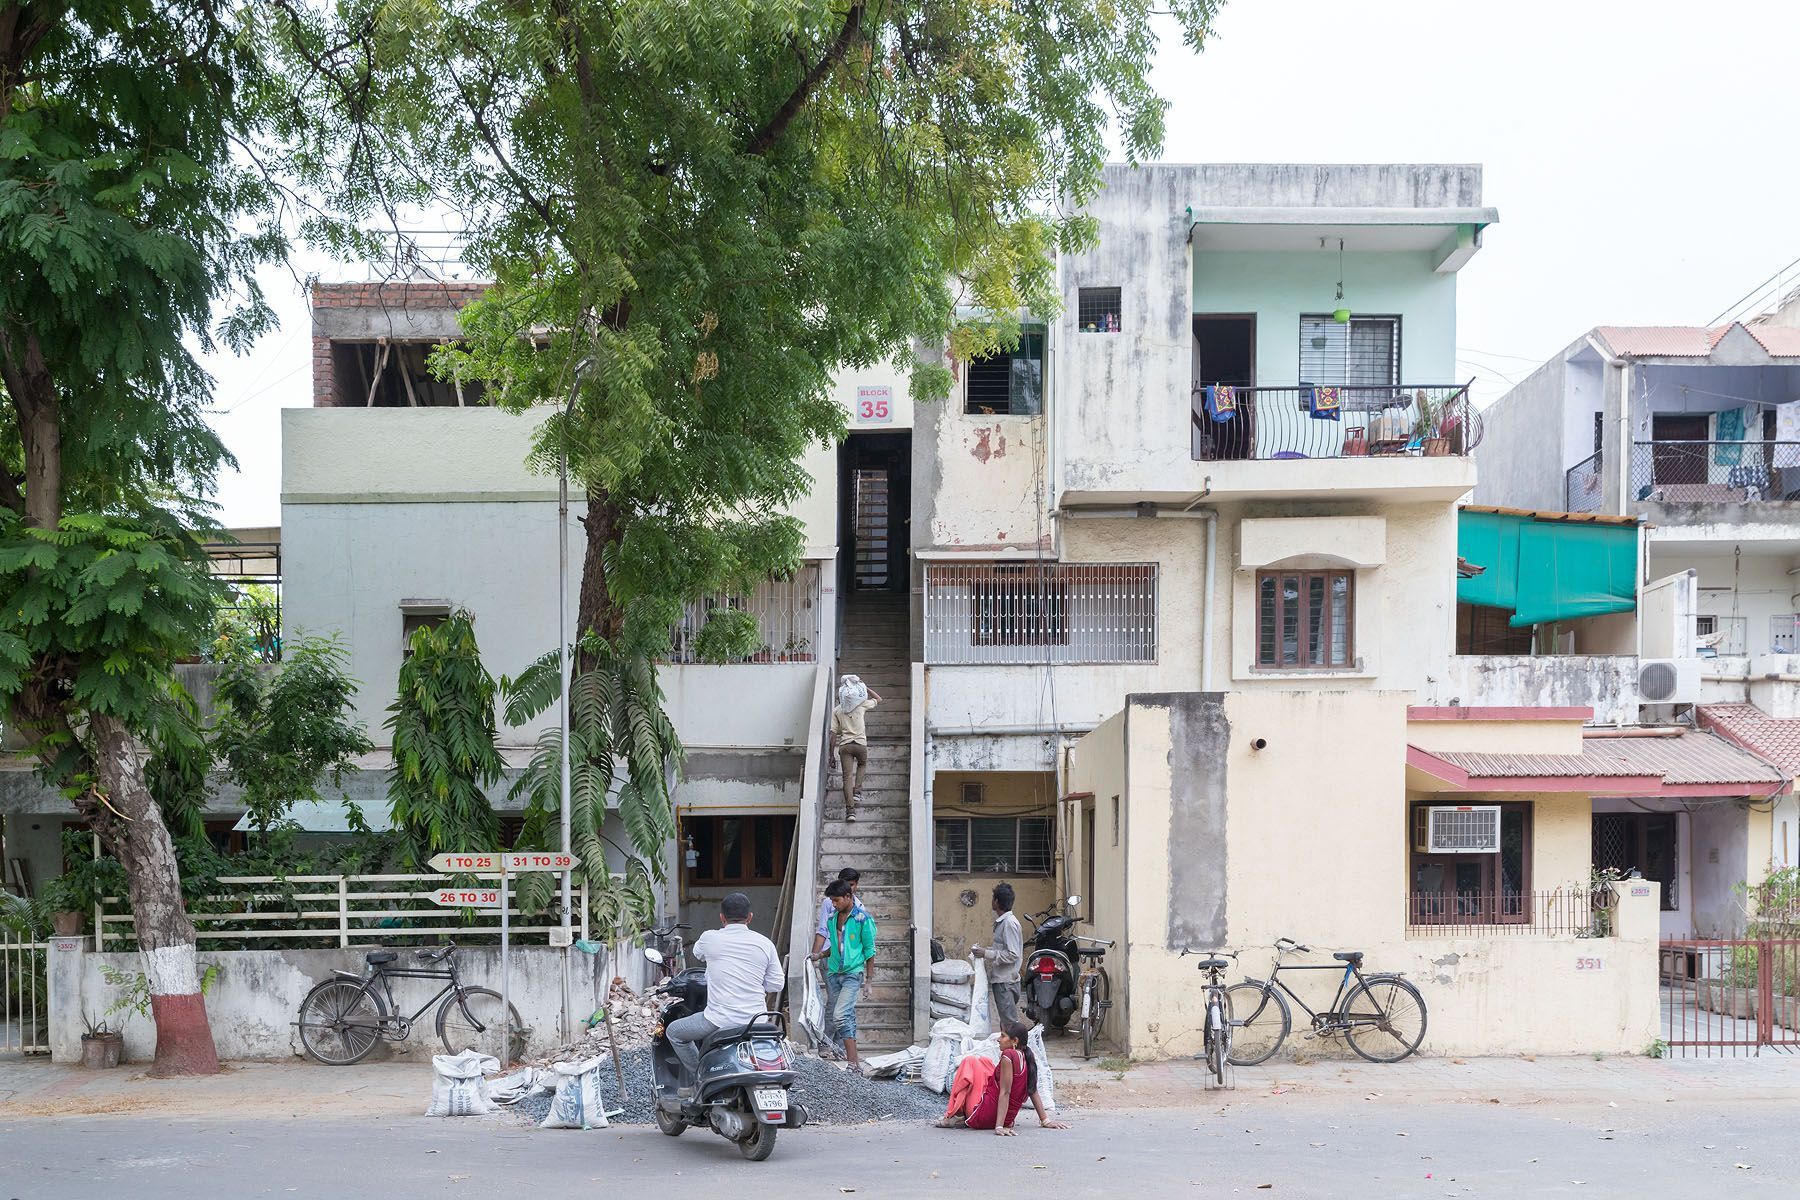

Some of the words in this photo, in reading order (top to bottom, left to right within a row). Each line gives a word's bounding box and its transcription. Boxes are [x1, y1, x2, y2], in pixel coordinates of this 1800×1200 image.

[861, 400, 889, 418] 35
[445, 858, 451, 867] 1
[456, 858, 473, 867] TO
[476, 858, 491, 867] 25
[513, 857, 528, 866] 31
[532, 857, 551, 866] TO
[554, 857, 571, 866] 39
[440, 893, 456, 902] 26
[459, 893, 477, 902] TO
[481, 893, 497, 902] 30
[1576, 958, 1601, 969] 351
